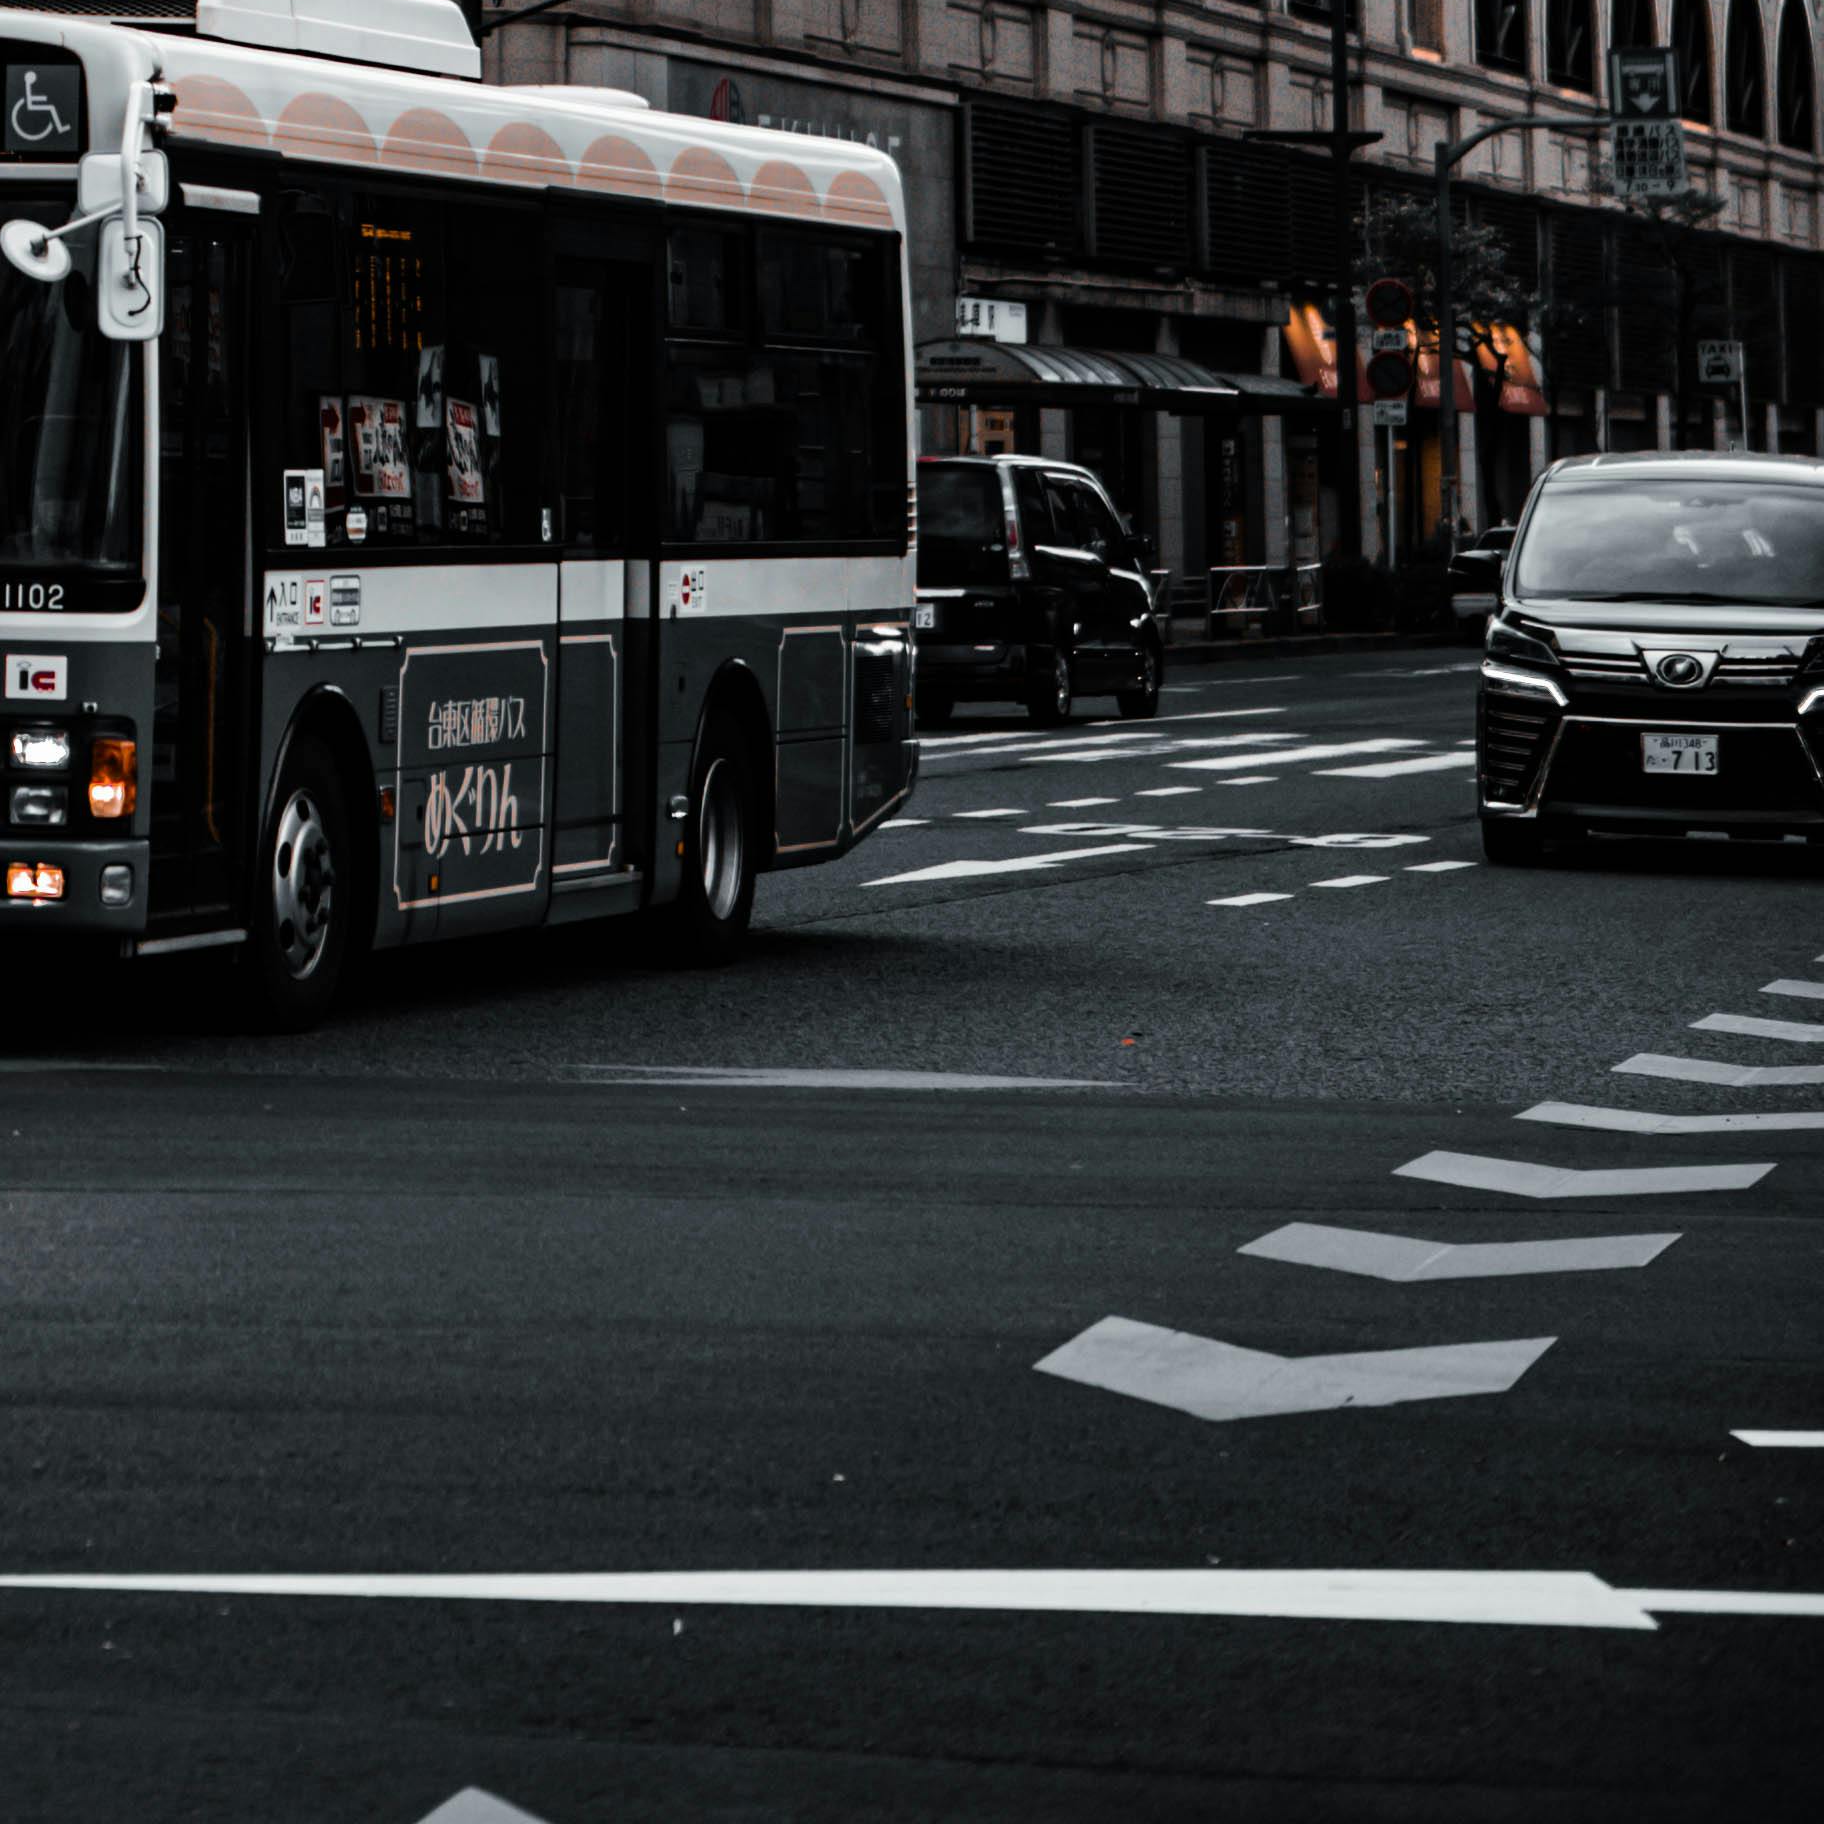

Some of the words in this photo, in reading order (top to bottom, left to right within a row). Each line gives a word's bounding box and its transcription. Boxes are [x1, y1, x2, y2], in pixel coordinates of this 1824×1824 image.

[1697, 343, 1733, 355] TAXI
[4, 583, 65, 610] 1102
[279, 581, 298, 607] 入口
[428, 696, 526, 750] 台東区循環バス
[424, 762, 524, 859] めぐりん
